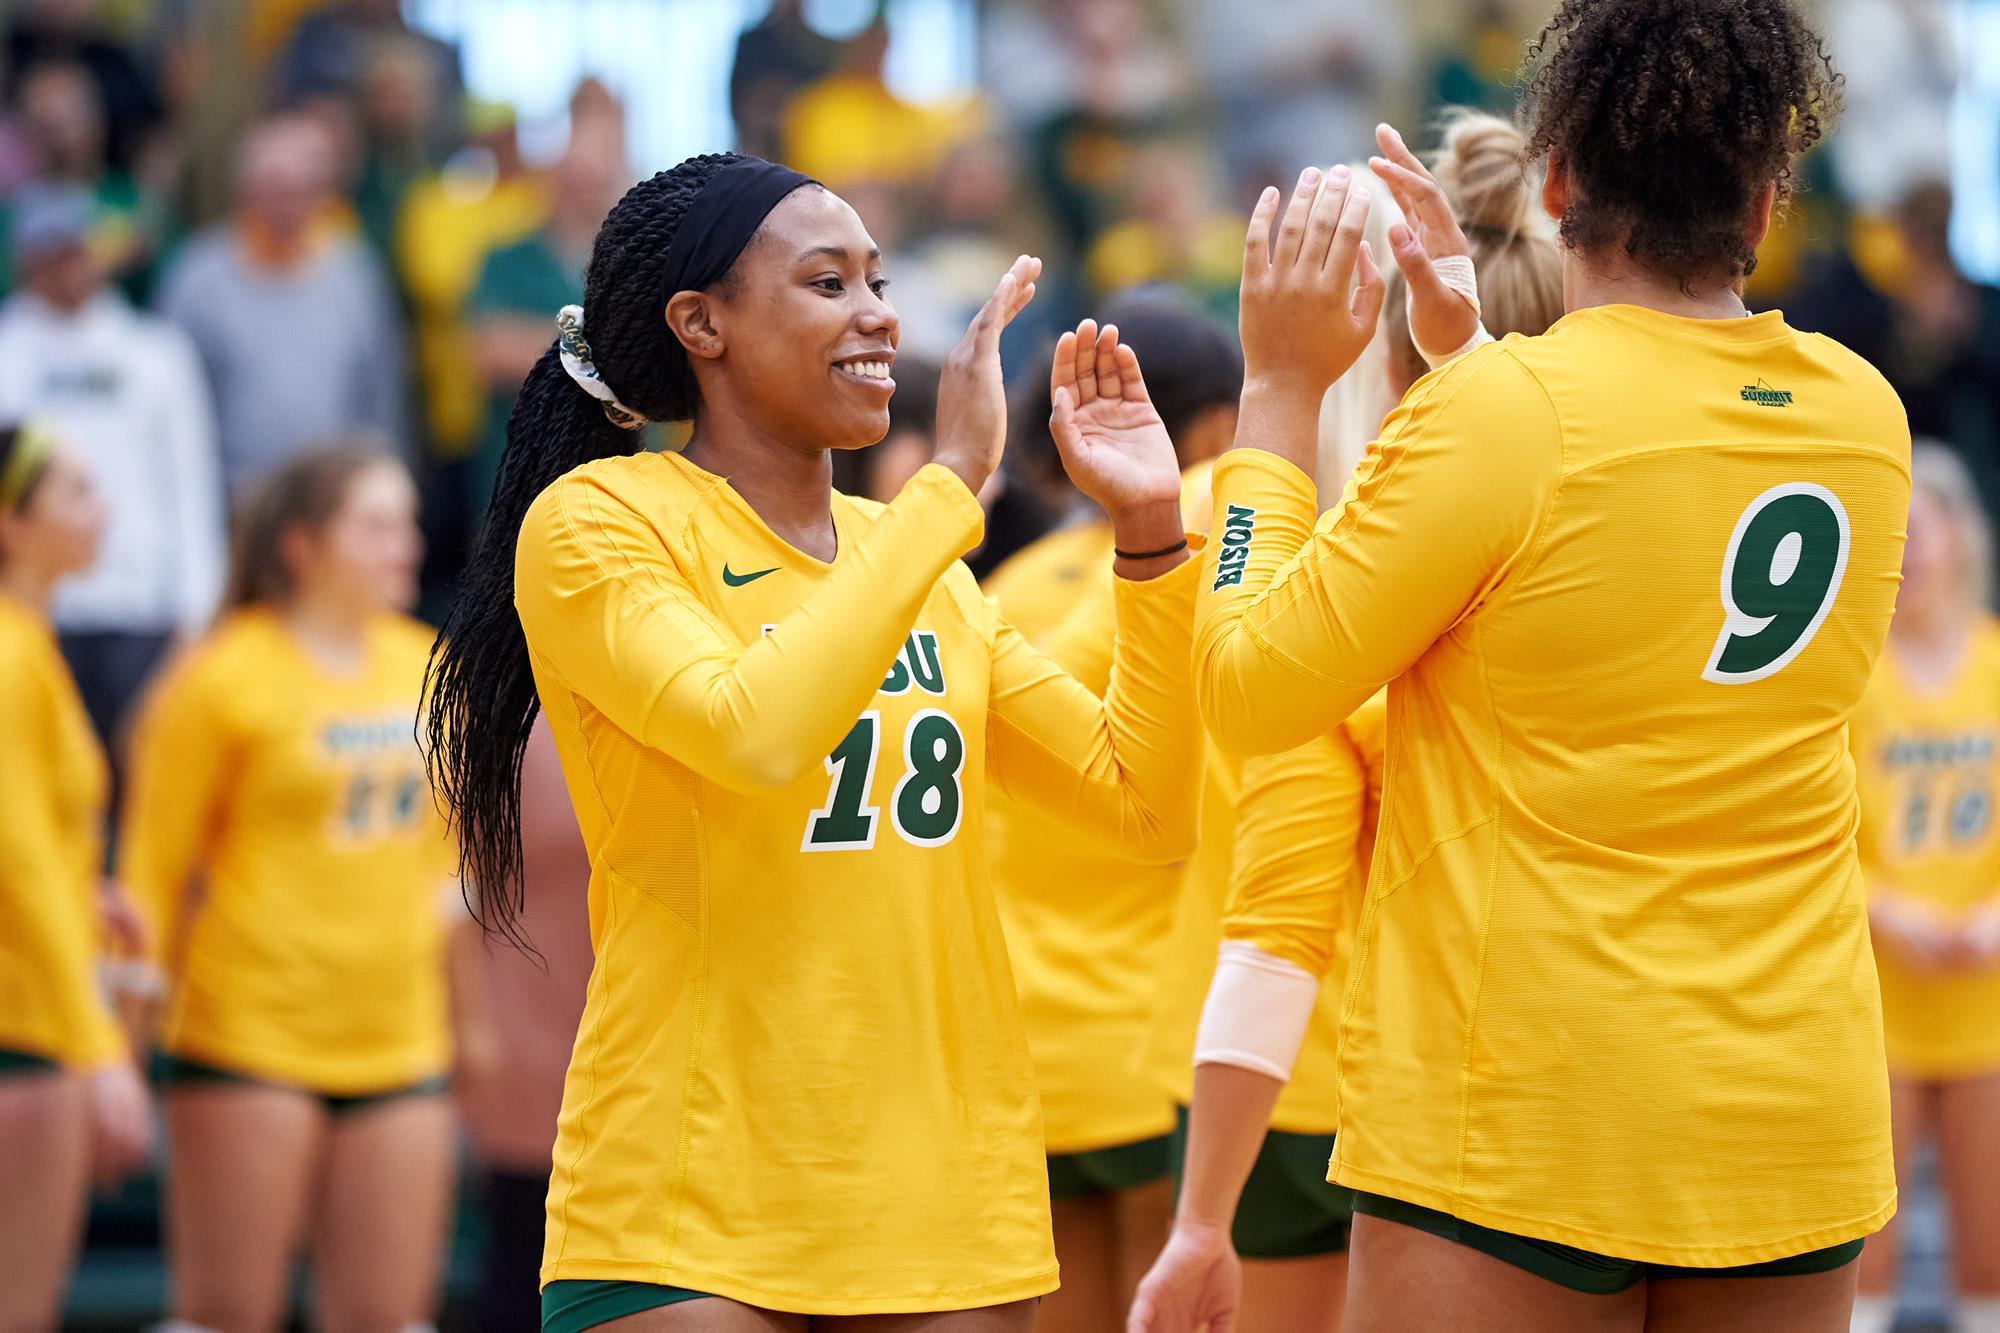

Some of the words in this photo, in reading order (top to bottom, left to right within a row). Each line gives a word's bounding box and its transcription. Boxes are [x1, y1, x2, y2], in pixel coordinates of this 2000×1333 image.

[1740, 389, 1793, 404] SUMMIT
[1212, 504, 1256, 593] BISON
[1701, 482, 1851, 685] 9
[800, 708, 966, 852] 18
